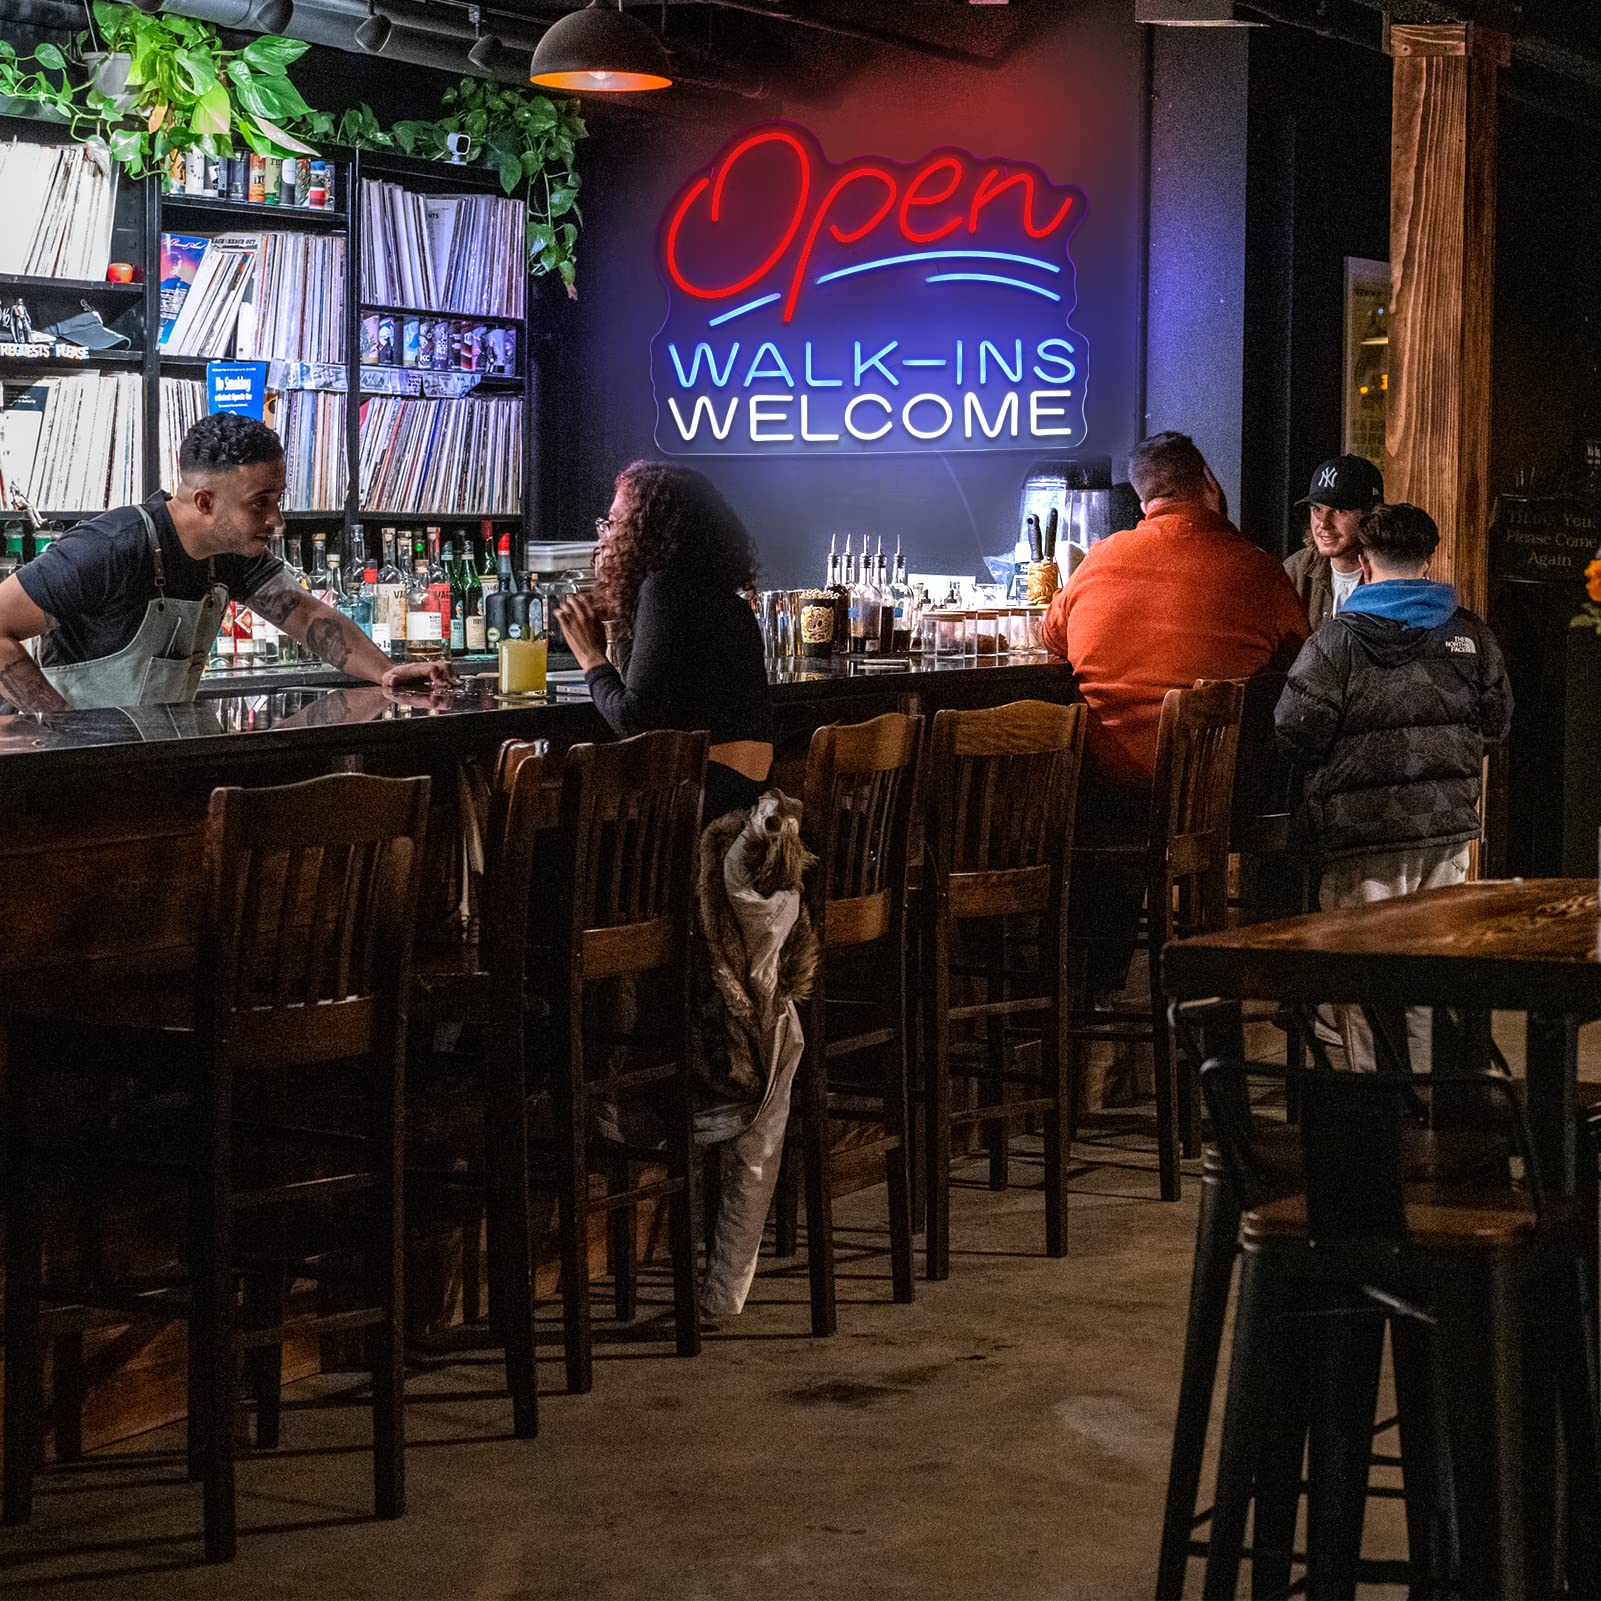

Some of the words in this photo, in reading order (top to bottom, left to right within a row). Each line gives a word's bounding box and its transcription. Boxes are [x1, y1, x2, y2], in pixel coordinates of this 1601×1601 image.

[667, 131, 1073, 323] Open
[668, 338, 1076, 388] WALK-INS
[668, 390, 1072, 442] WELCOME
[1317, 466, 1339, 489] NY
